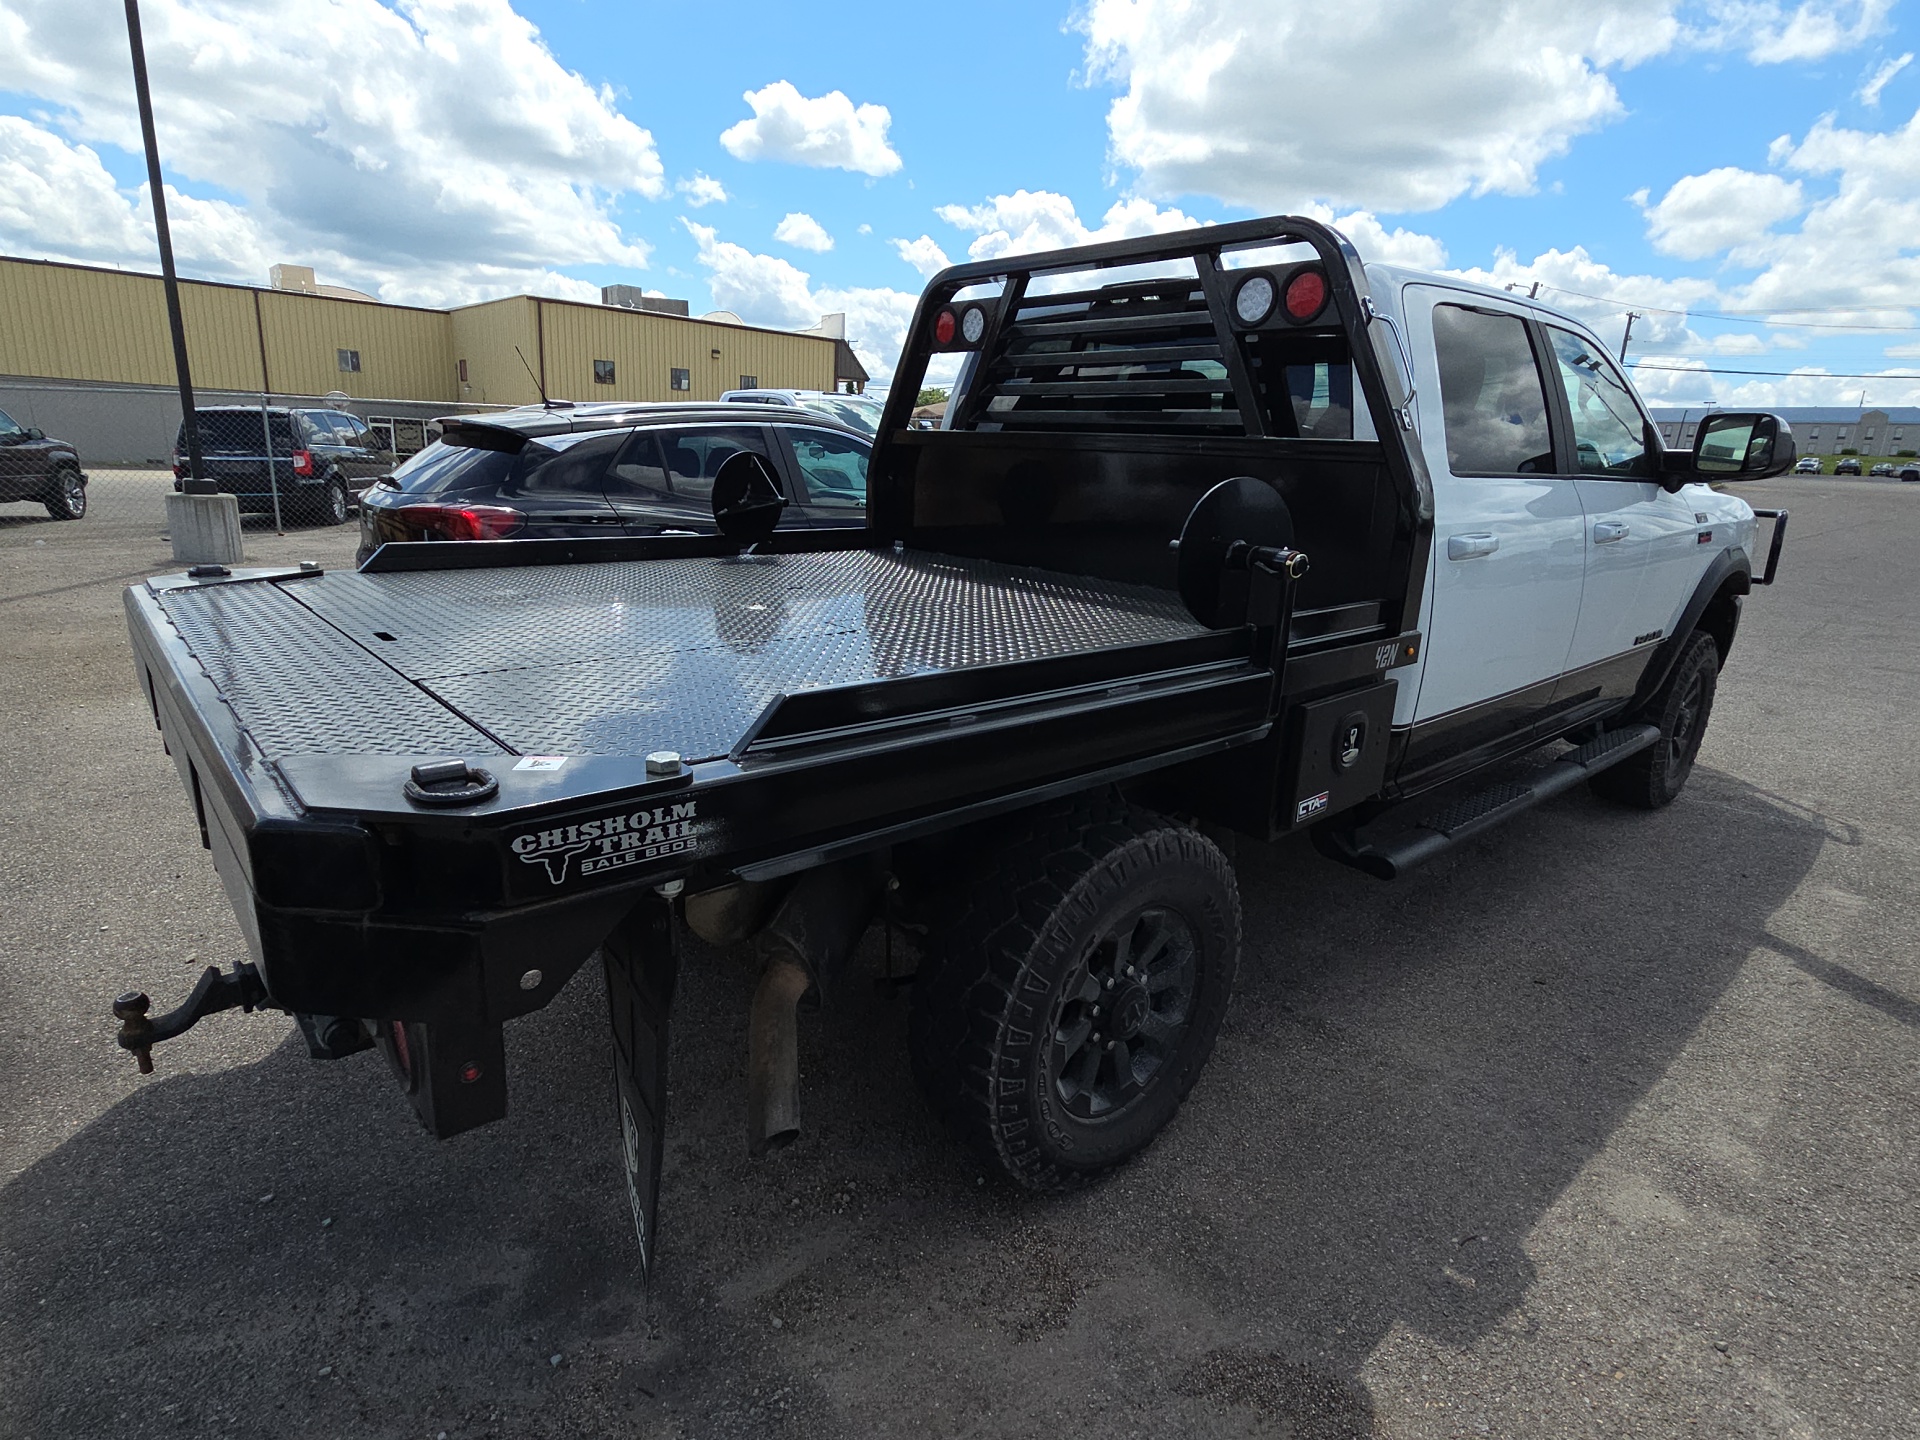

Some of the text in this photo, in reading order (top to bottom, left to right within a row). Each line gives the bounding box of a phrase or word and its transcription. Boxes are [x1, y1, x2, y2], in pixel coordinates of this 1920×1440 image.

[1299, 797, 1321, 815] CTA
[510, 801, 697, 854] CHISHOLM
[595, 819, 698, 854] TRAIL
[581, 838, 697, 872] BALE BEDS
